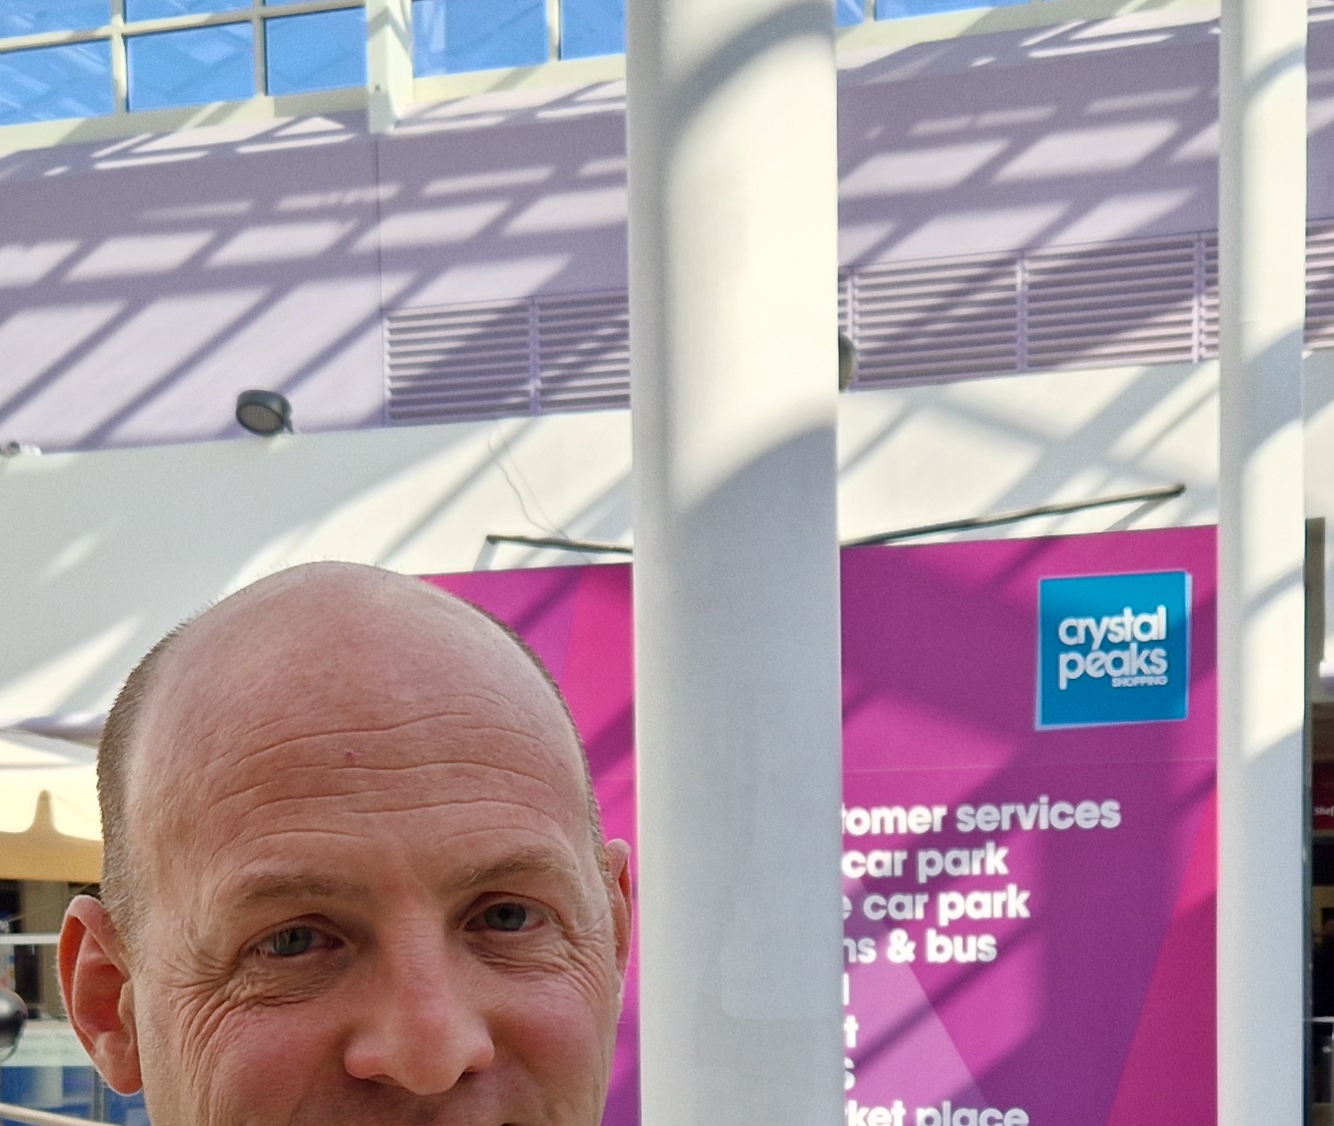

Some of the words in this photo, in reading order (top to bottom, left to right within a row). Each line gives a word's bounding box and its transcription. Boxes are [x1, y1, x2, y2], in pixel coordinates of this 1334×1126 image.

[1058, 604, 1167, 651] crystal
[1058, 642, 1168, 691] peaks
[1111, 675, 1168, 688] SHOPPING
[955, 794, 1122, 833] services
[917, 840, 1009, 883] park
[862, 892, 929, 920] car
[938, 883, 1031, 927] park
[887, 928, 916, 963] &
[926, 929, 998, 963] bus
